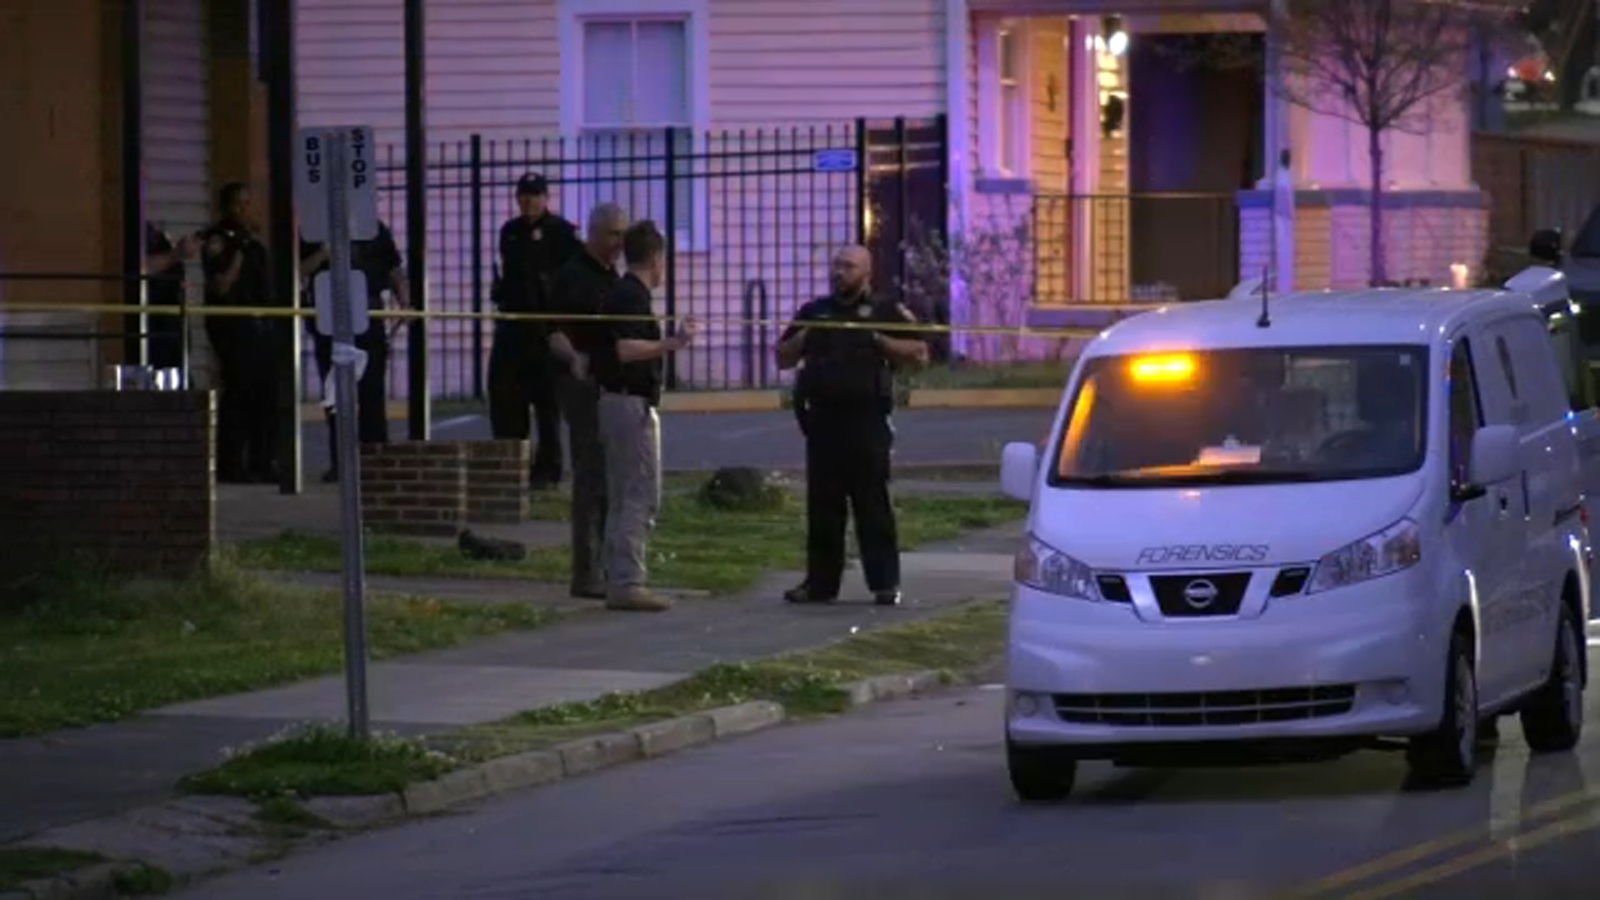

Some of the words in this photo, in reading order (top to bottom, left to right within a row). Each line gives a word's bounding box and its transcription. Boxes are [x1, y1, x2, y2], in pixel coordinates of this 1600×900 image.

[306, 136, 320, 183] BUS
[351, 127, 366, 189] STOP
[1135, 543, 1270, 565] FORENSICS
